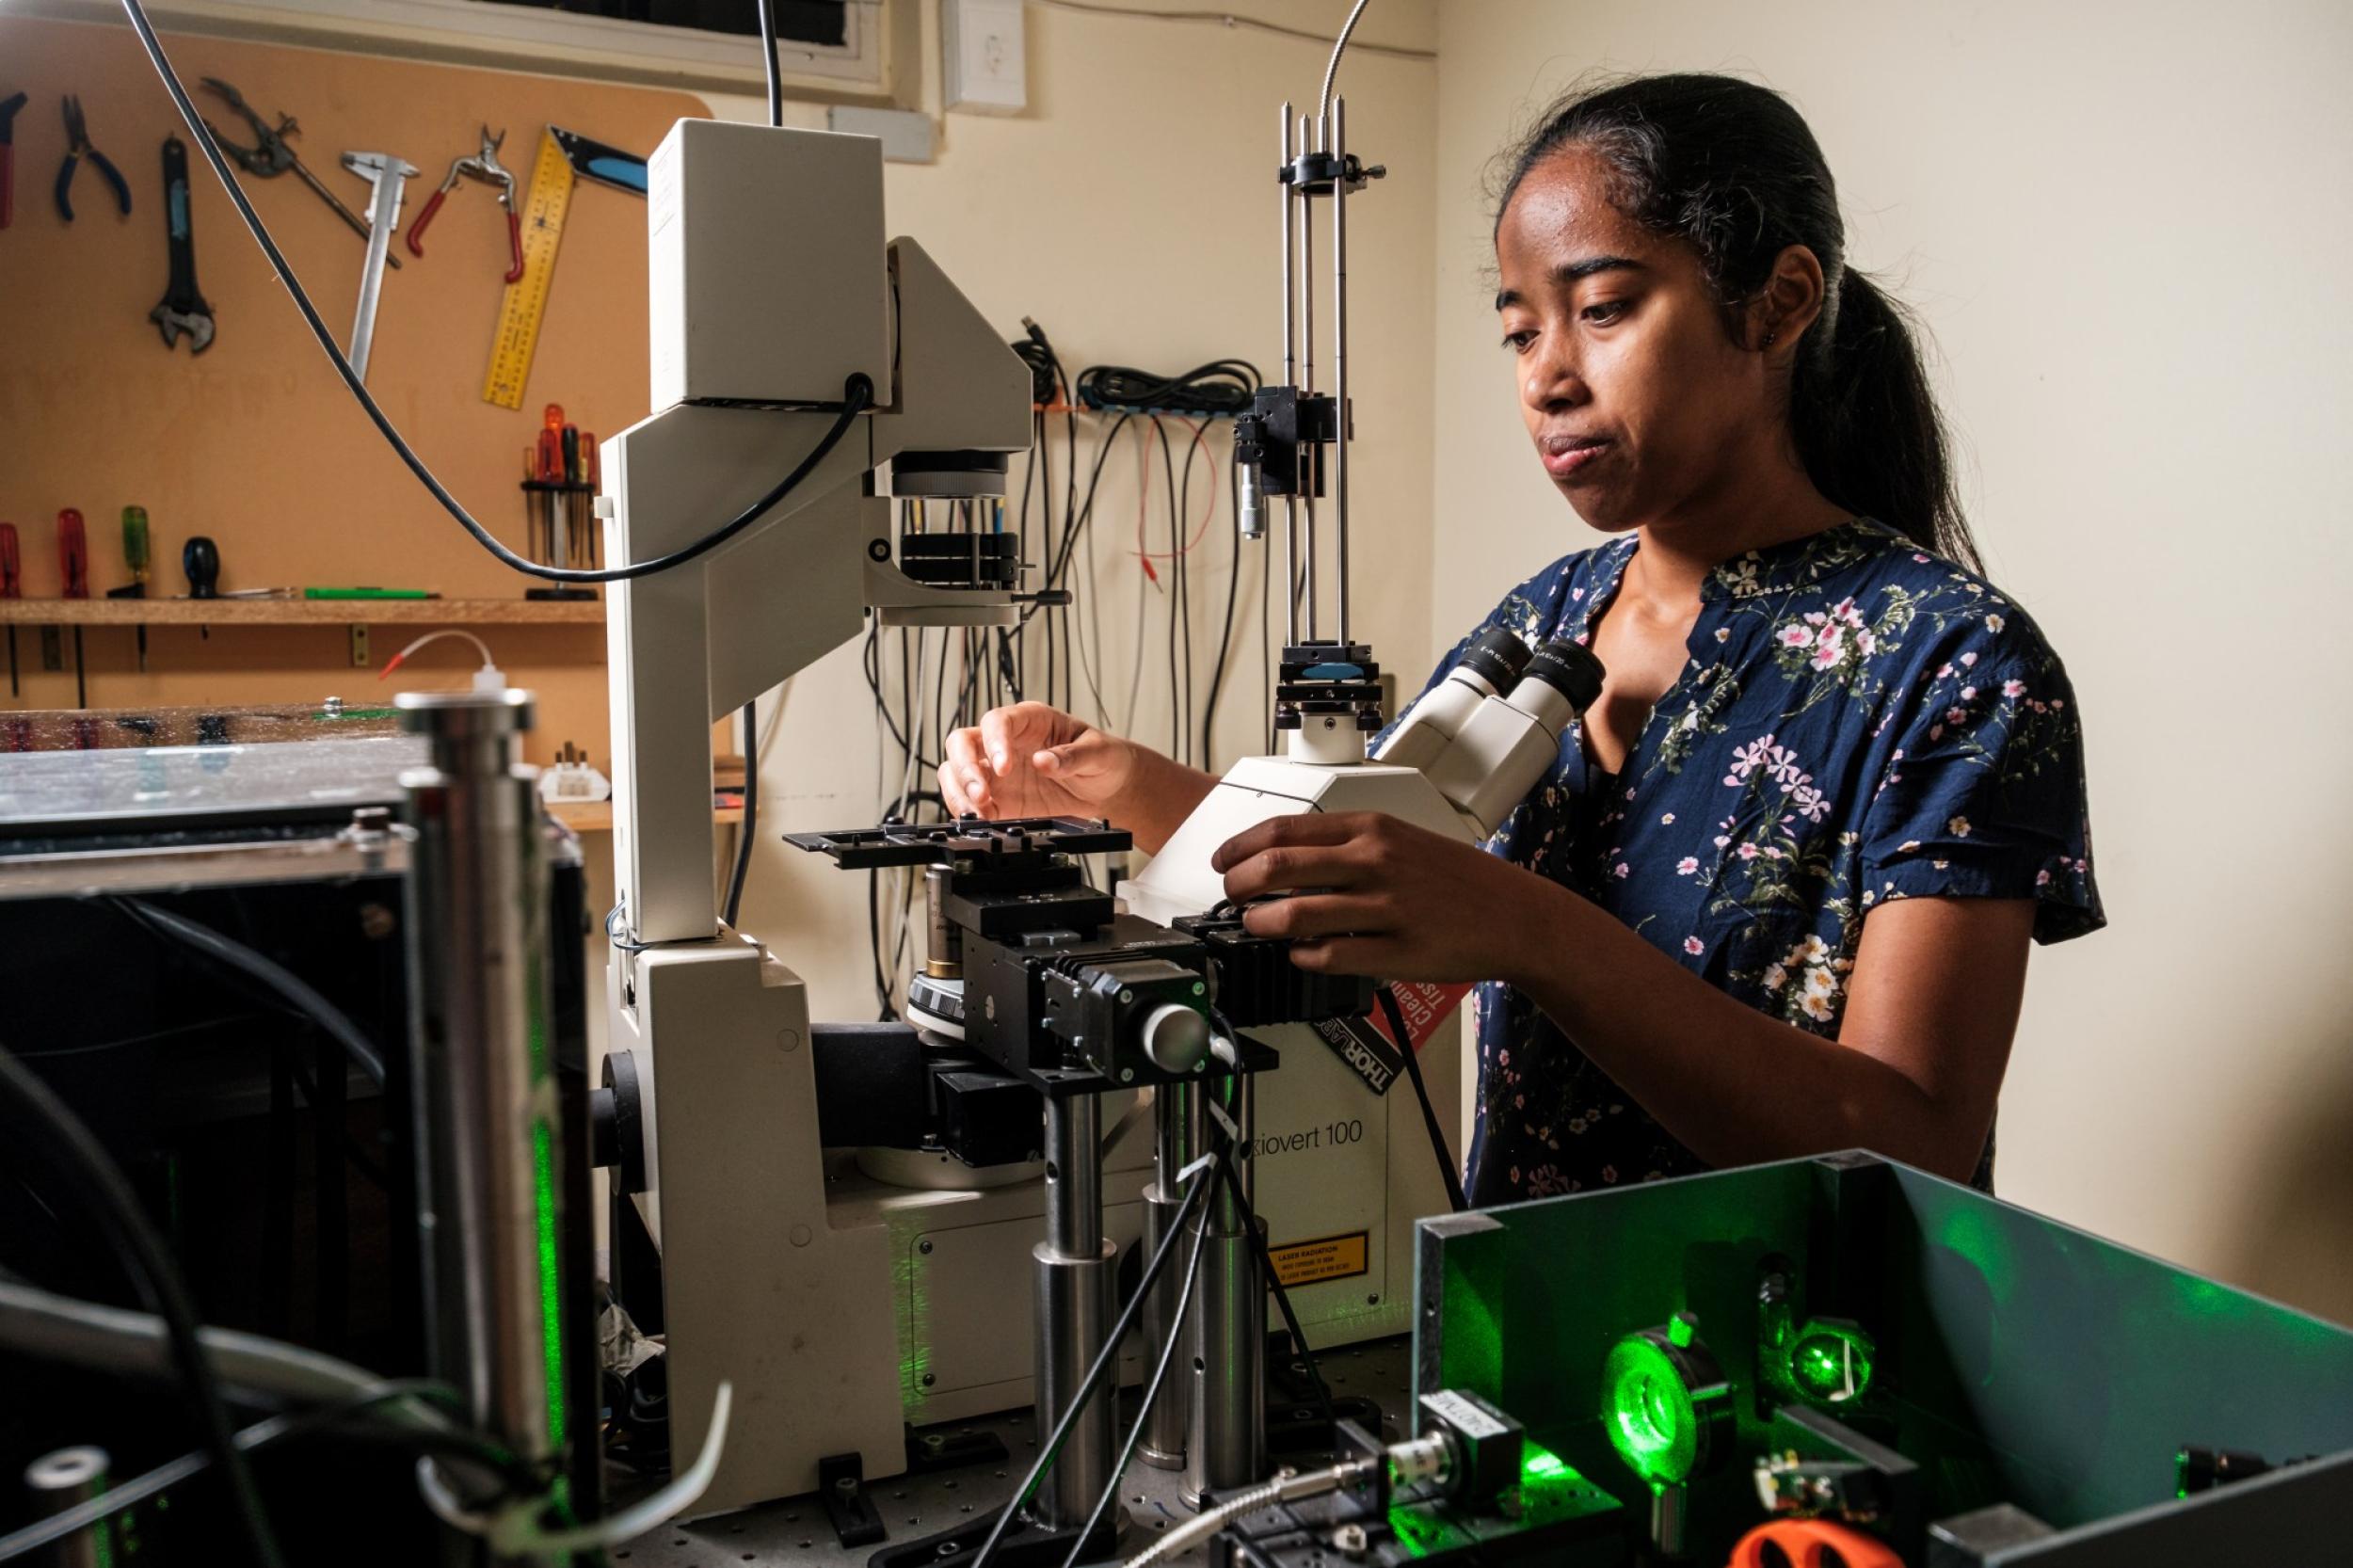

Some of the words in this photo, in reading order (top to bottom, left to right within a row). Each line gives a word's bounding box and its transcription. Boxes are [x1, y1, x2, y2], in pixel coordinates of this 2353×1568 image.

[1314, 1016, 1388, 1091] THORLAB
[1253, 1127, 1320, 1157] xiovert
[1325, 1119, 1362, 1145] 100
